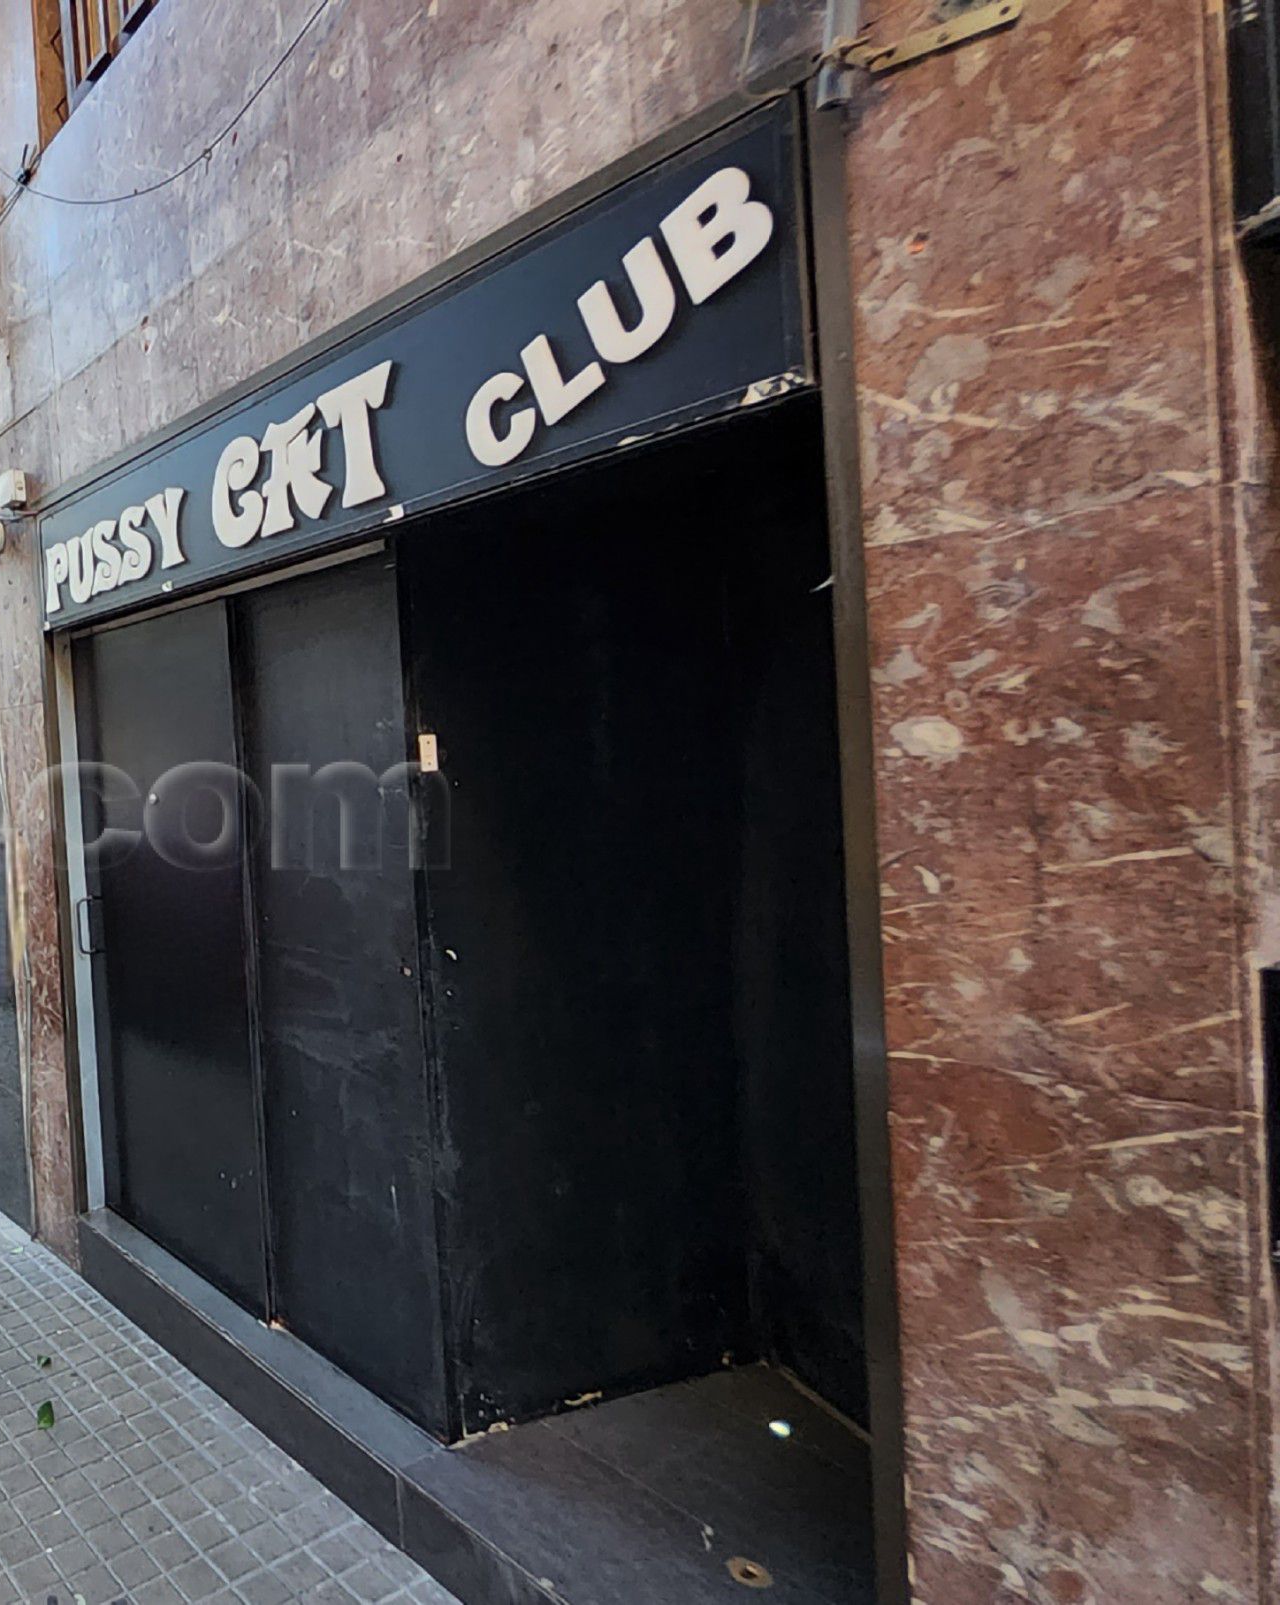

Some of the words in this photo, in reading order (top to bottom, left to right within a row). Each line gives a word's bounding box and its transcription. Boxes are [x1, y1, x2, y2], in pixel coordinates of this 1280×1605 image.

[44, 486, 185, 613] PUSSY
[211, 360, 394, 548] CAT
[465, 166, 774, 468] CLUB
